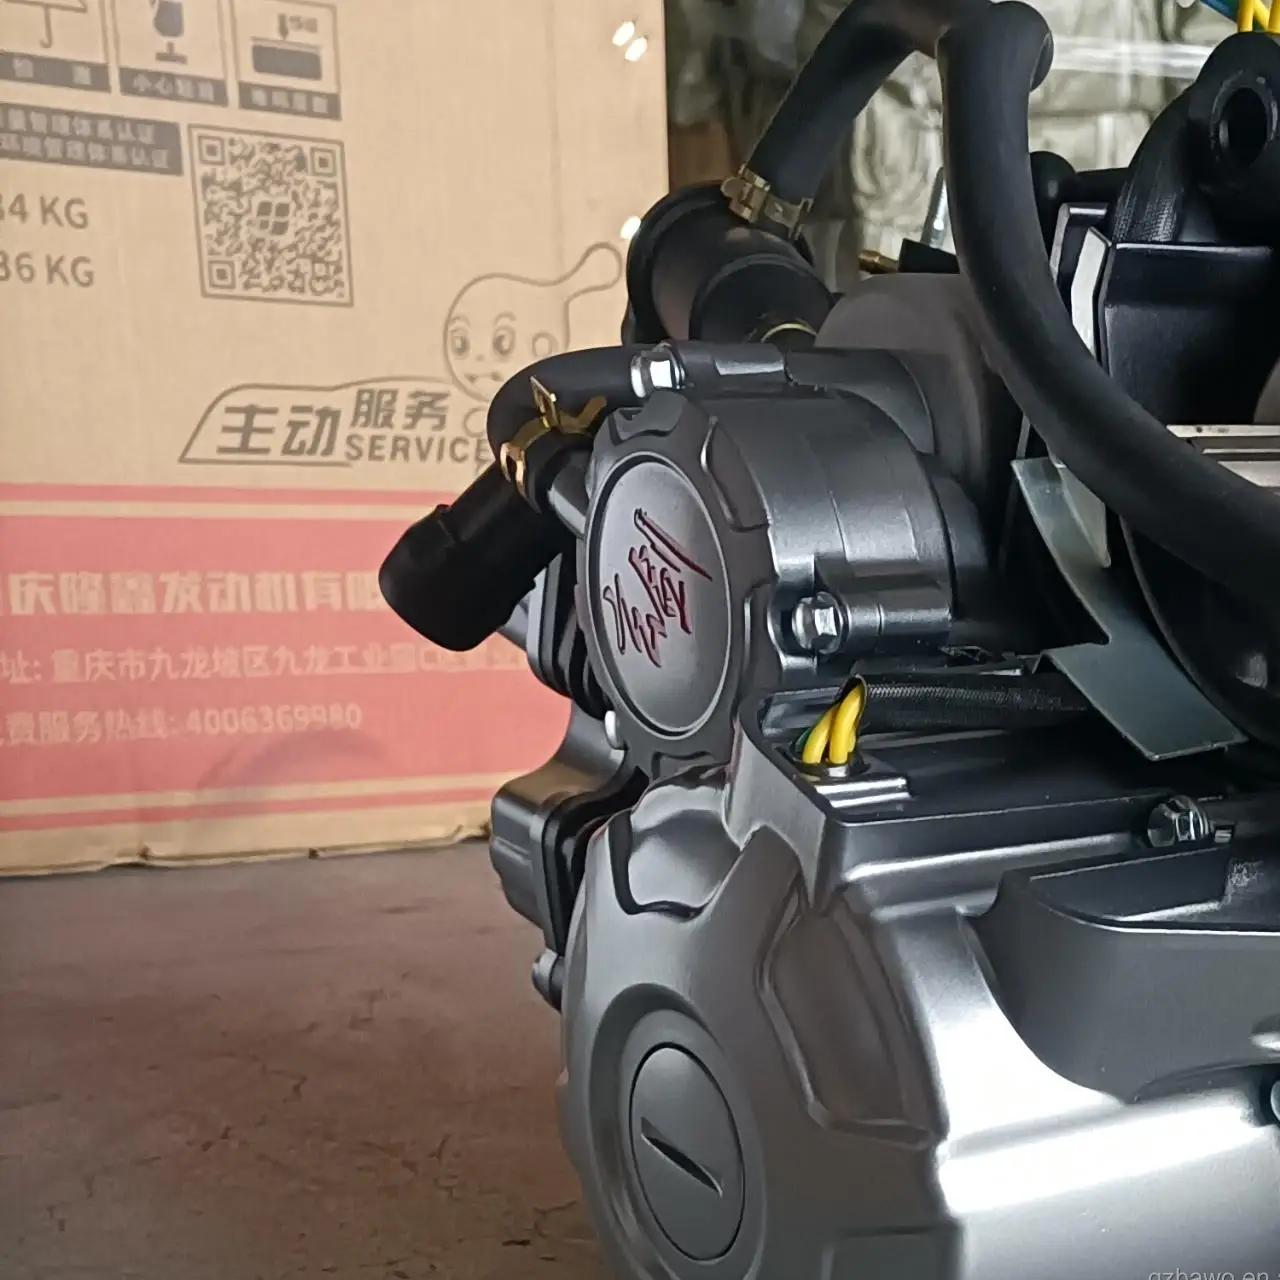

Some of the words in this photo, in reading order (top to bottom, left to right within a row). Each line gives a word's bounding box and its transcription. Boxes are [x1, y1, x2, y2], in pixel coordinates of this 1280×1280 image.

[0, 192, 28, 224] 4
[40, 195, 89, 230] KG
[45, 253, 95, 288] KG
[349, 387, 450, 431] 服务
[216, 403, 342, 457] 主动
[345, 434, 493, 464] SERVICE
